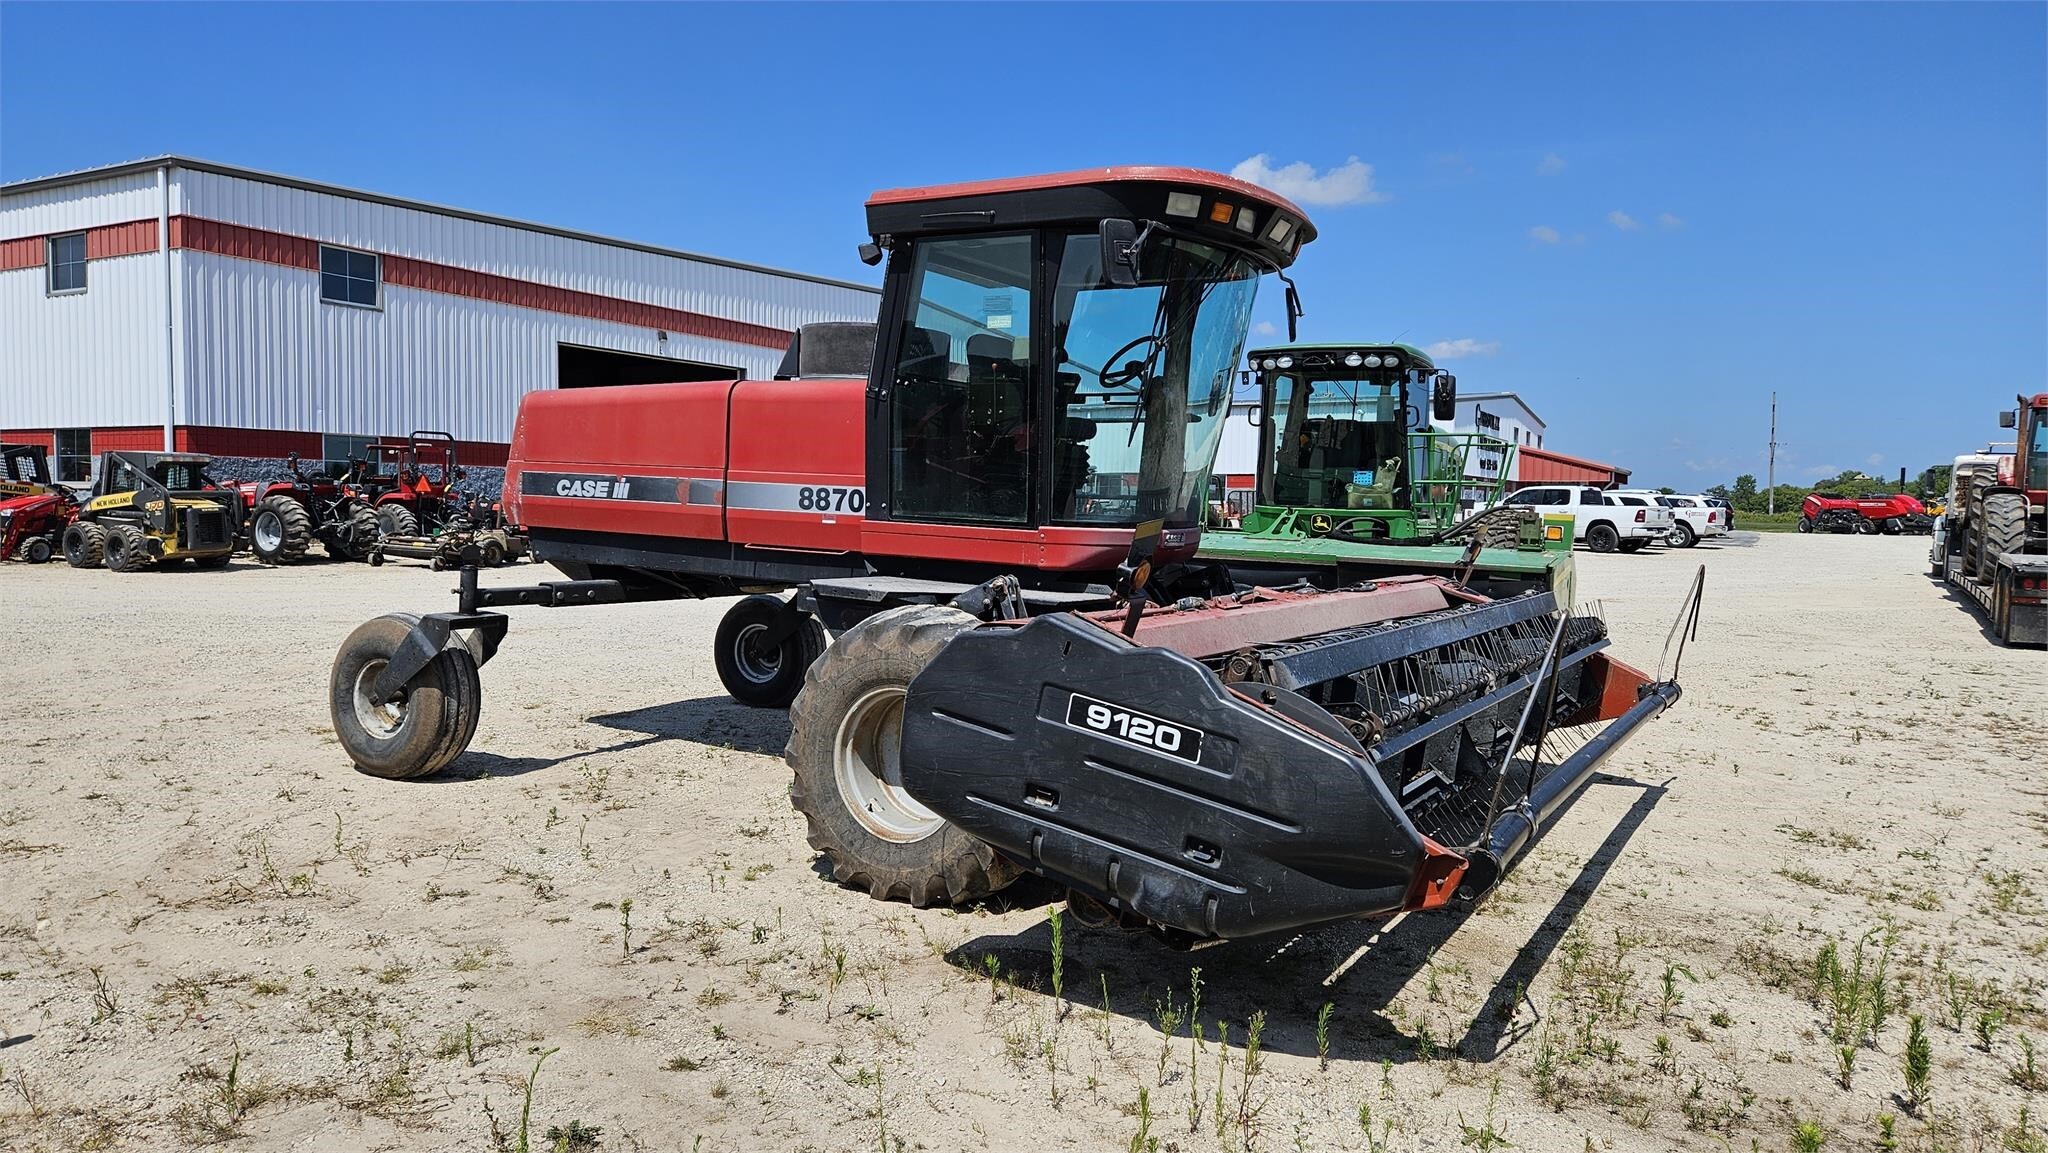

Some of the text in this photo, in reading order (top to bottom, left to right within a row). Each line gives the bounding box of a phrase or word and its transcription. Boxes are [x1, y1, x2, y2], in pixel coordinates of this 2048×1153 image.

[556, 479, 609, 497] CASE
[96, 496, 130, 508] NEW HOLLAND
[798, 486, 865, 513] 8870
[1086, 704, 1182, 752] 9120
